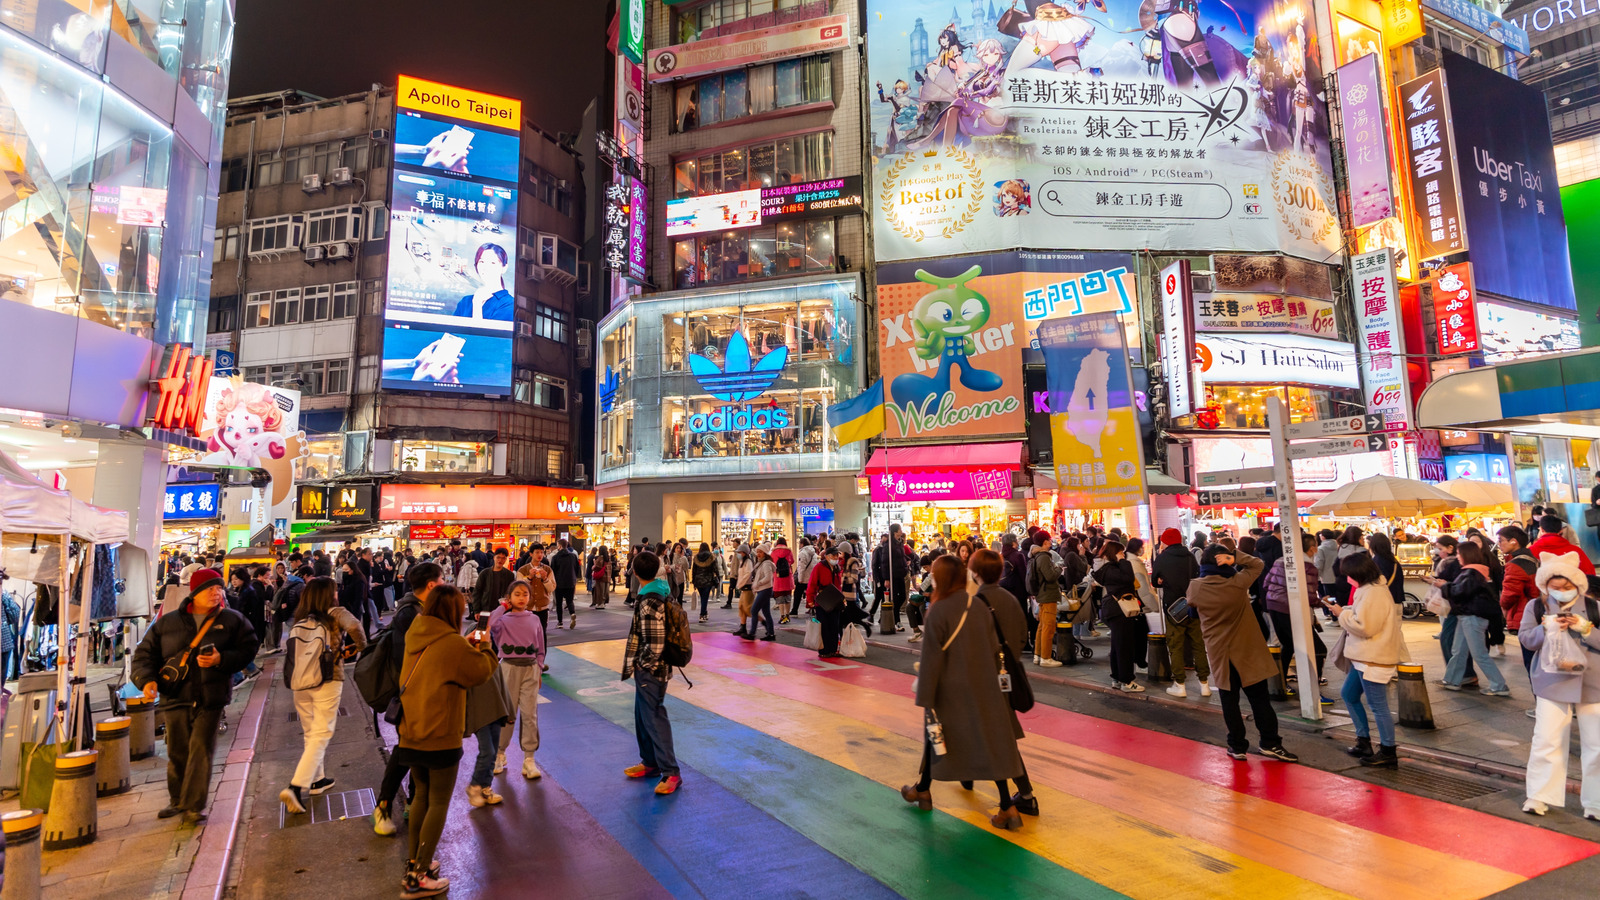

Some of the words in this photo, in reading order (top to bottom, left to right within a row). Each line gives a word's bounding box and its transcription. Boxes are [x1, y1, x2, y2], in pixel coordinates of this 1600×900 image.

[1509, 0, 1600, 31] ORL
[824, 28, 838, 37] 6F
[408, 87, 460, 109] Apollo
[466, 98, 513, 120] Taipei
[1024, 125, 1078, 135] Resleriana
[1041, 117, 1077, 126] Atelier
[1084, 115, 1189, 142] 鍊金工房
[1352, 108, 1372, 165] 湯の花
[1410, 119, 1443, 178] 駭客
[1053, 166, 1072, 175] iOS
[1473, 146, 1513, 182] Uber
[1515, 161, 1543, 193] Taxi
[415, 189, 445, 209] 幸福
[446, 196, 497, 215] 不能被暫停
[761, 197, 785, 207] SOUR3
[899, 187, 942, 206] Best
[945, 181, 967, 199] of
[1479, 180, 1546, 216] 優步小黃
[919, 204, 947, 216] 2023
[1450, 240, 1460, 248] 4F
[1356, 253, 1387, 271] 玉芙蓉
[1022, 266, 1134, 320] 西門町
[1361, 276, 1388, 317] 按摩
[1199, 300, 1239, 317] 玉芙蓉
[1241, 304, 1255, 313] SPA
[1256, 298, 1286, 316] 按摩
[1287, 301, 1308, 317] 護膚
[1365, 321, 1390, 330] Massage
[1366, 330, 1393, 372] 護膚
[1466, 341, 1475, 349] 3F
[1260, 349, 1304, 366] Hair
[1307, 353, 1344, 372] Salon
[155, 344, 213, 437] H&M
[1369, 376, 1398, 385] Treatment
[688, 404, 789, 433] adidas
[885, 390, 1020, 438] Welcome
[1386, 422, 1404, 430] 上三樓
[340, 489, 357, 508] N
[557, 496, 580, 513] J&G
[801, 506, 818, 515] OPEN
